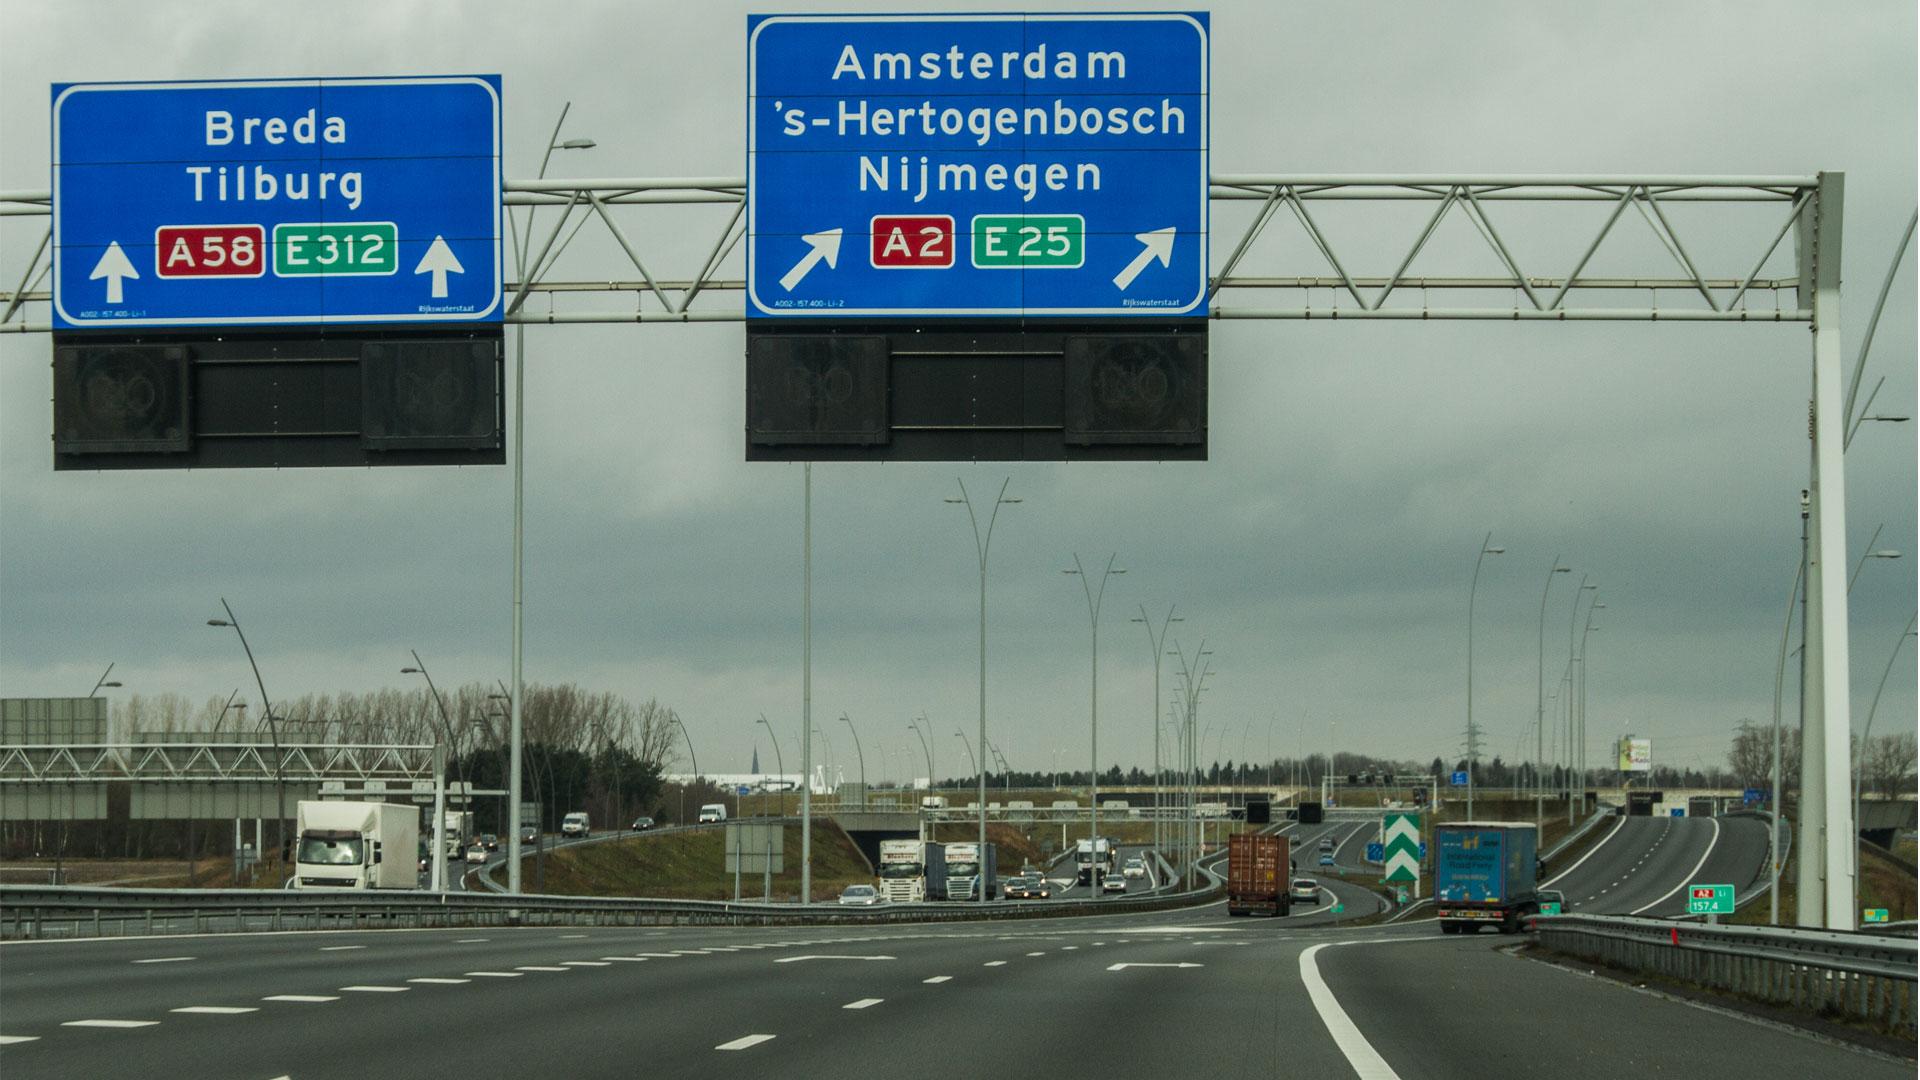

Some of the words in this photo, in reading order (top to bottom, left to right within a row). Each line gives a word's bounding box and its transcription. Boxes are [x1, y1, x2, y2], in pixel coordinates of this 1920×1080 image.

[831, 43, 1126, 80] Amsterdam
[206, 108, 346, 146] Breda
[774, 98, 1185, 146] 's-Hertogenbosch
[186, 165, 362, 210] Tilburg
[859, 155, 1100, 203] Nijmegen
[166, 235, 256, 268] A58
[286, 233, 385, 265] E312
[1698, 889, 1711, 898] A2
